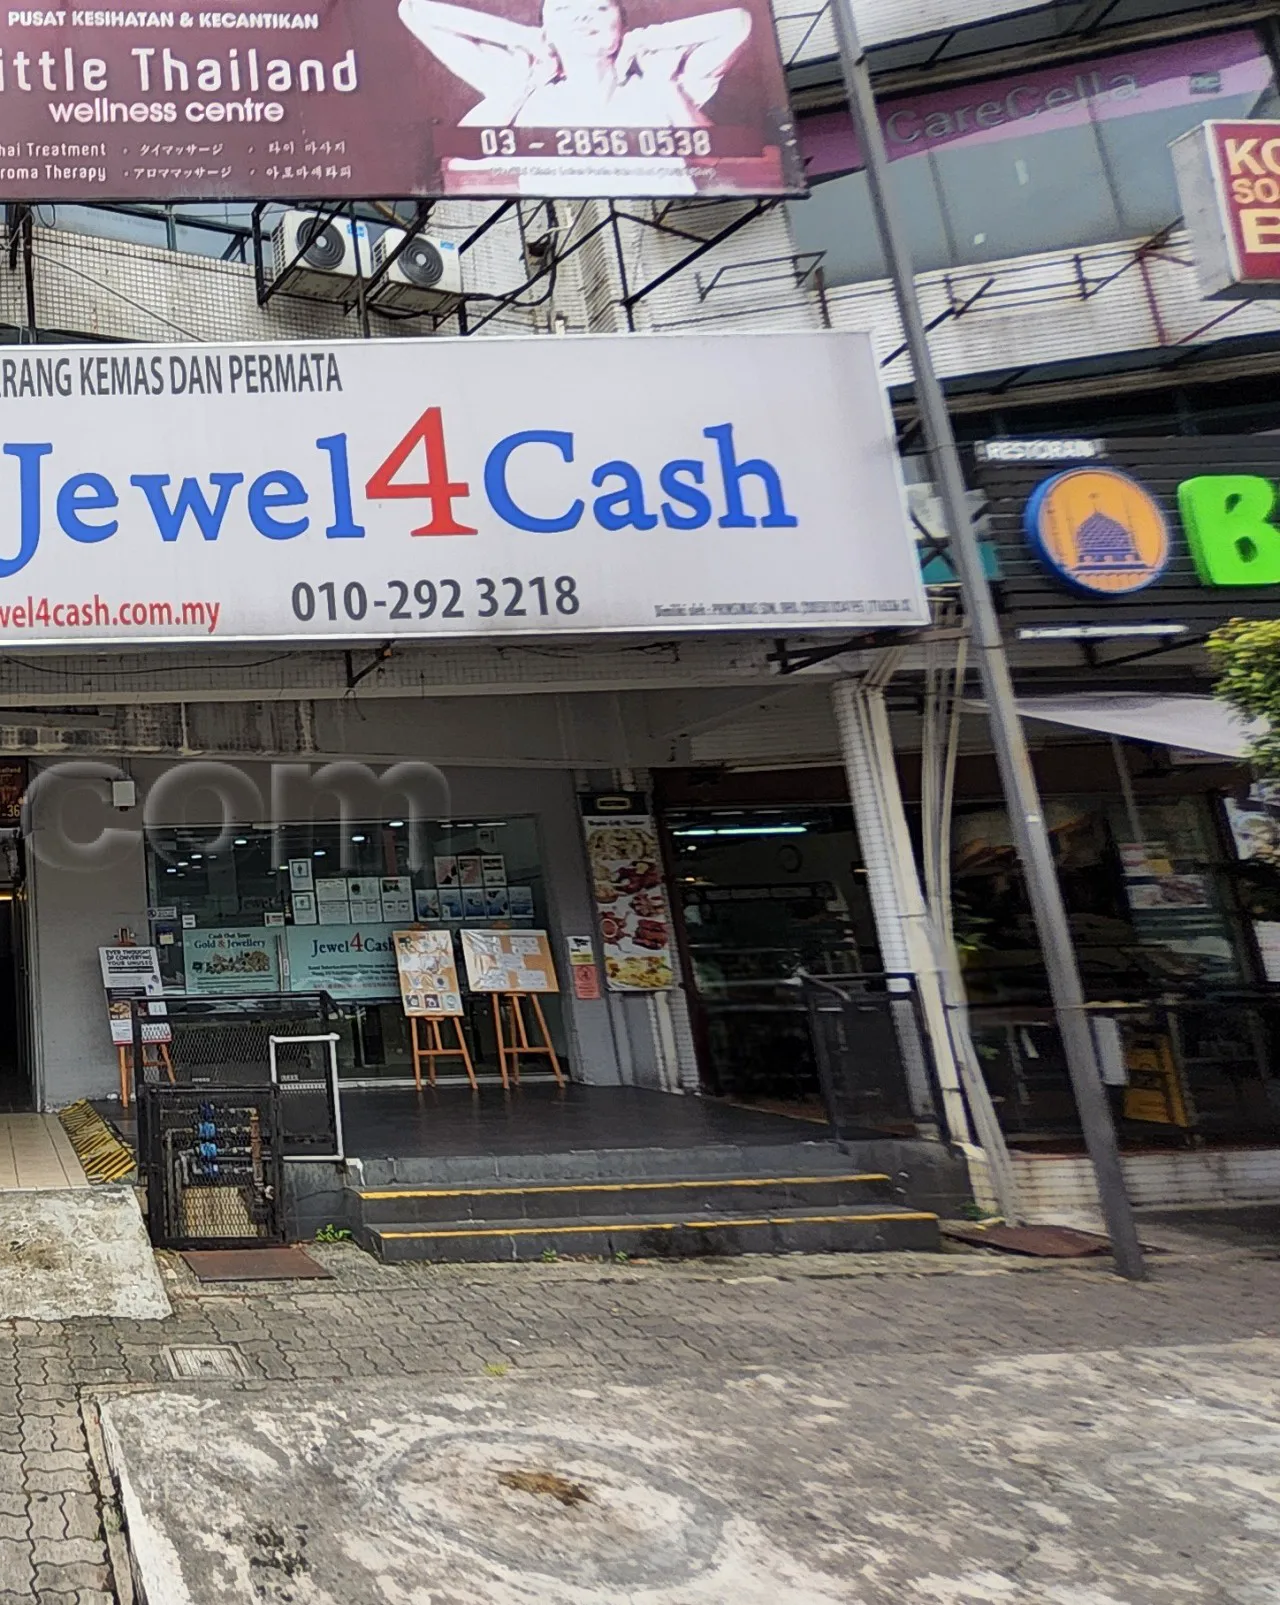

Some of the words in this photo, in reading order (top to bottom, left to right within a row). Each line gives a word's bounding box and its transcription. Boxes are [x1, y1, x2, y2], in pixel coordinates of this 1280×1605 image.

[7, 11, 67, 27] PUSAT
[71, 11, 174, 28] KESIHATAN
[179, 11, 194, 28] &
[199, 12, 320, 29] KECANTIKAN
[131, 47, 358, 92] Thailand
[48, 97, 177, 124] wellness
[184, 97, 285, 123] centre
[885, 70, 1140, 146] CareCella
[26, 142, 107, 158] Treatment
[480, 128, 517, 156] 03
[555, 129, 629, 157] 2856
[638, 129, 712, 157] 0538
[44, 164, 107, 182] Therapy
[79, 355, 165, 396] KEMAS
[169, 354, 223, 395] DAN
[229, 352, 344, 394] PERMATA
[290, 579, 465, 622] 010-292
[477, 575, 581, 618] 3218
[193, 939, 216, 949] Gold
[227, 938, 266, 950] Jewellery
